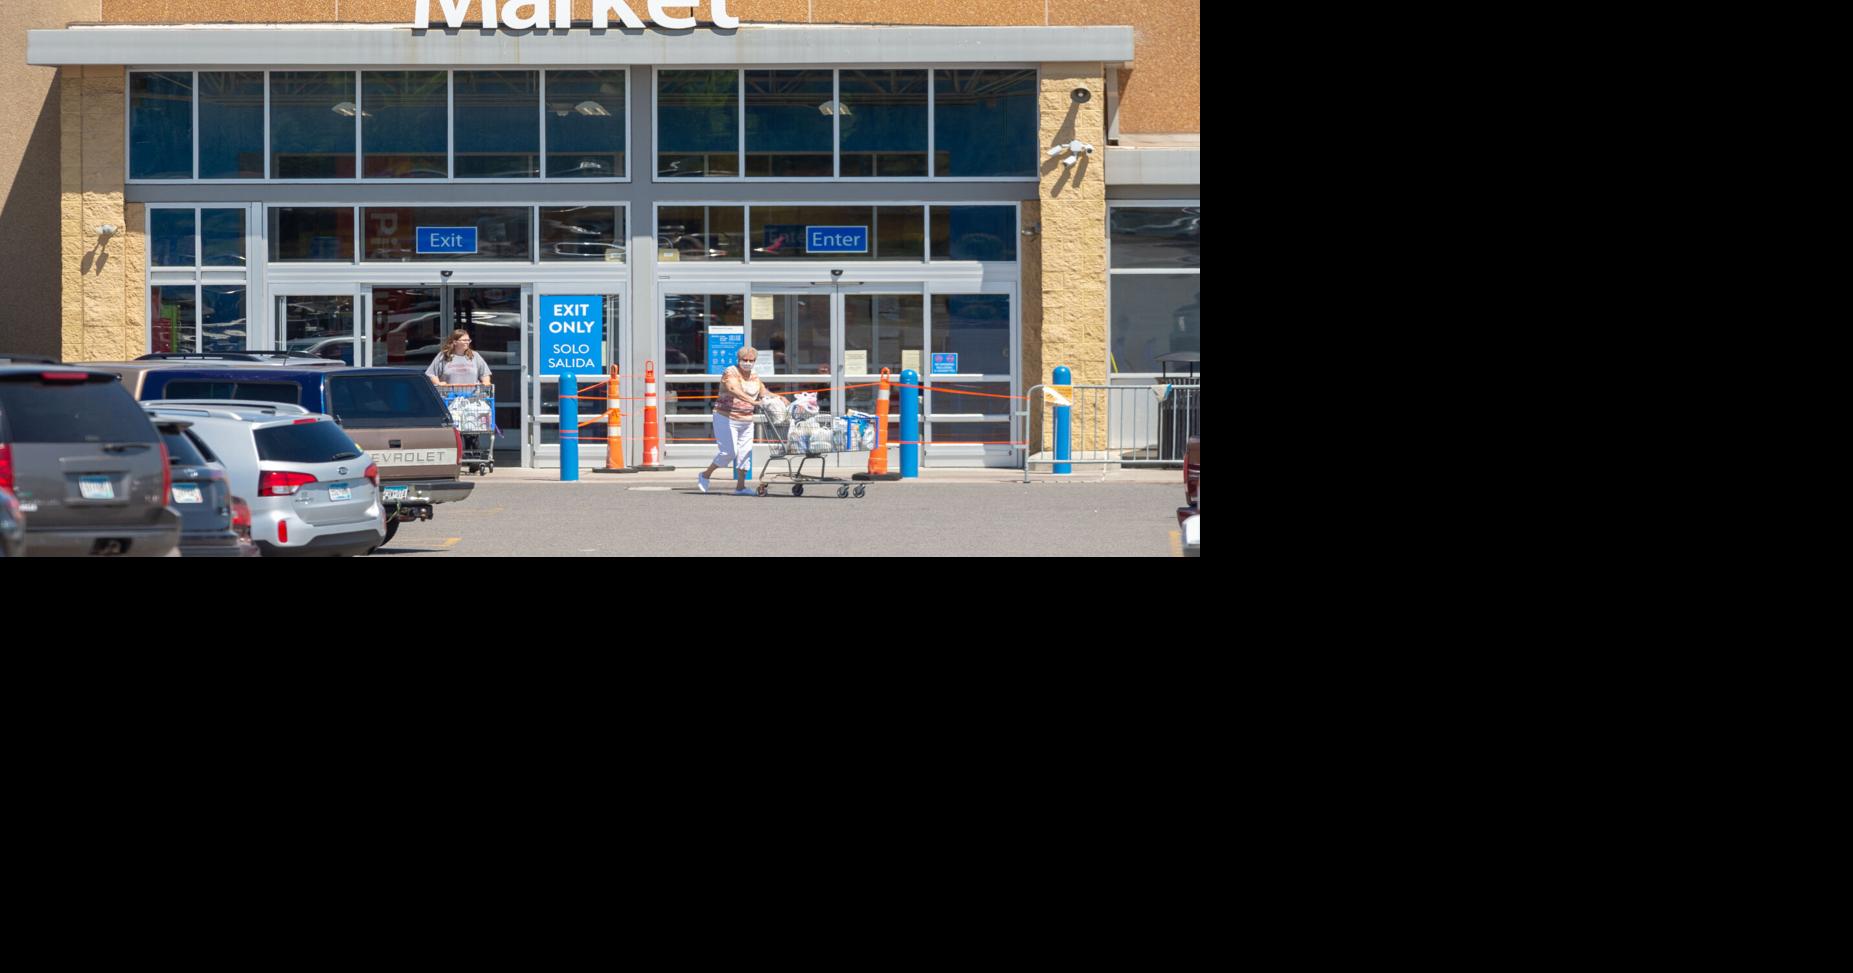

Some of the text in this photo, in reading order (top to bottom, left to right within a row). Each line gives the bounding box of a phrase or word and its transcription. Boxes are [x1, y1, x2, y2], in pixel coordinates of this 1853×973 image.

[430, 233, 463, 248] Exit
[812, 232, 861, 247] Enter
[553, 304, 589, 317] EXIT
[548, 321, 595, 334] ONLY
[553, 343, 590, 354] SOLO
[548, 358, 595, 368] SALIDA
[371, 451, 446, 463] EVROLET
